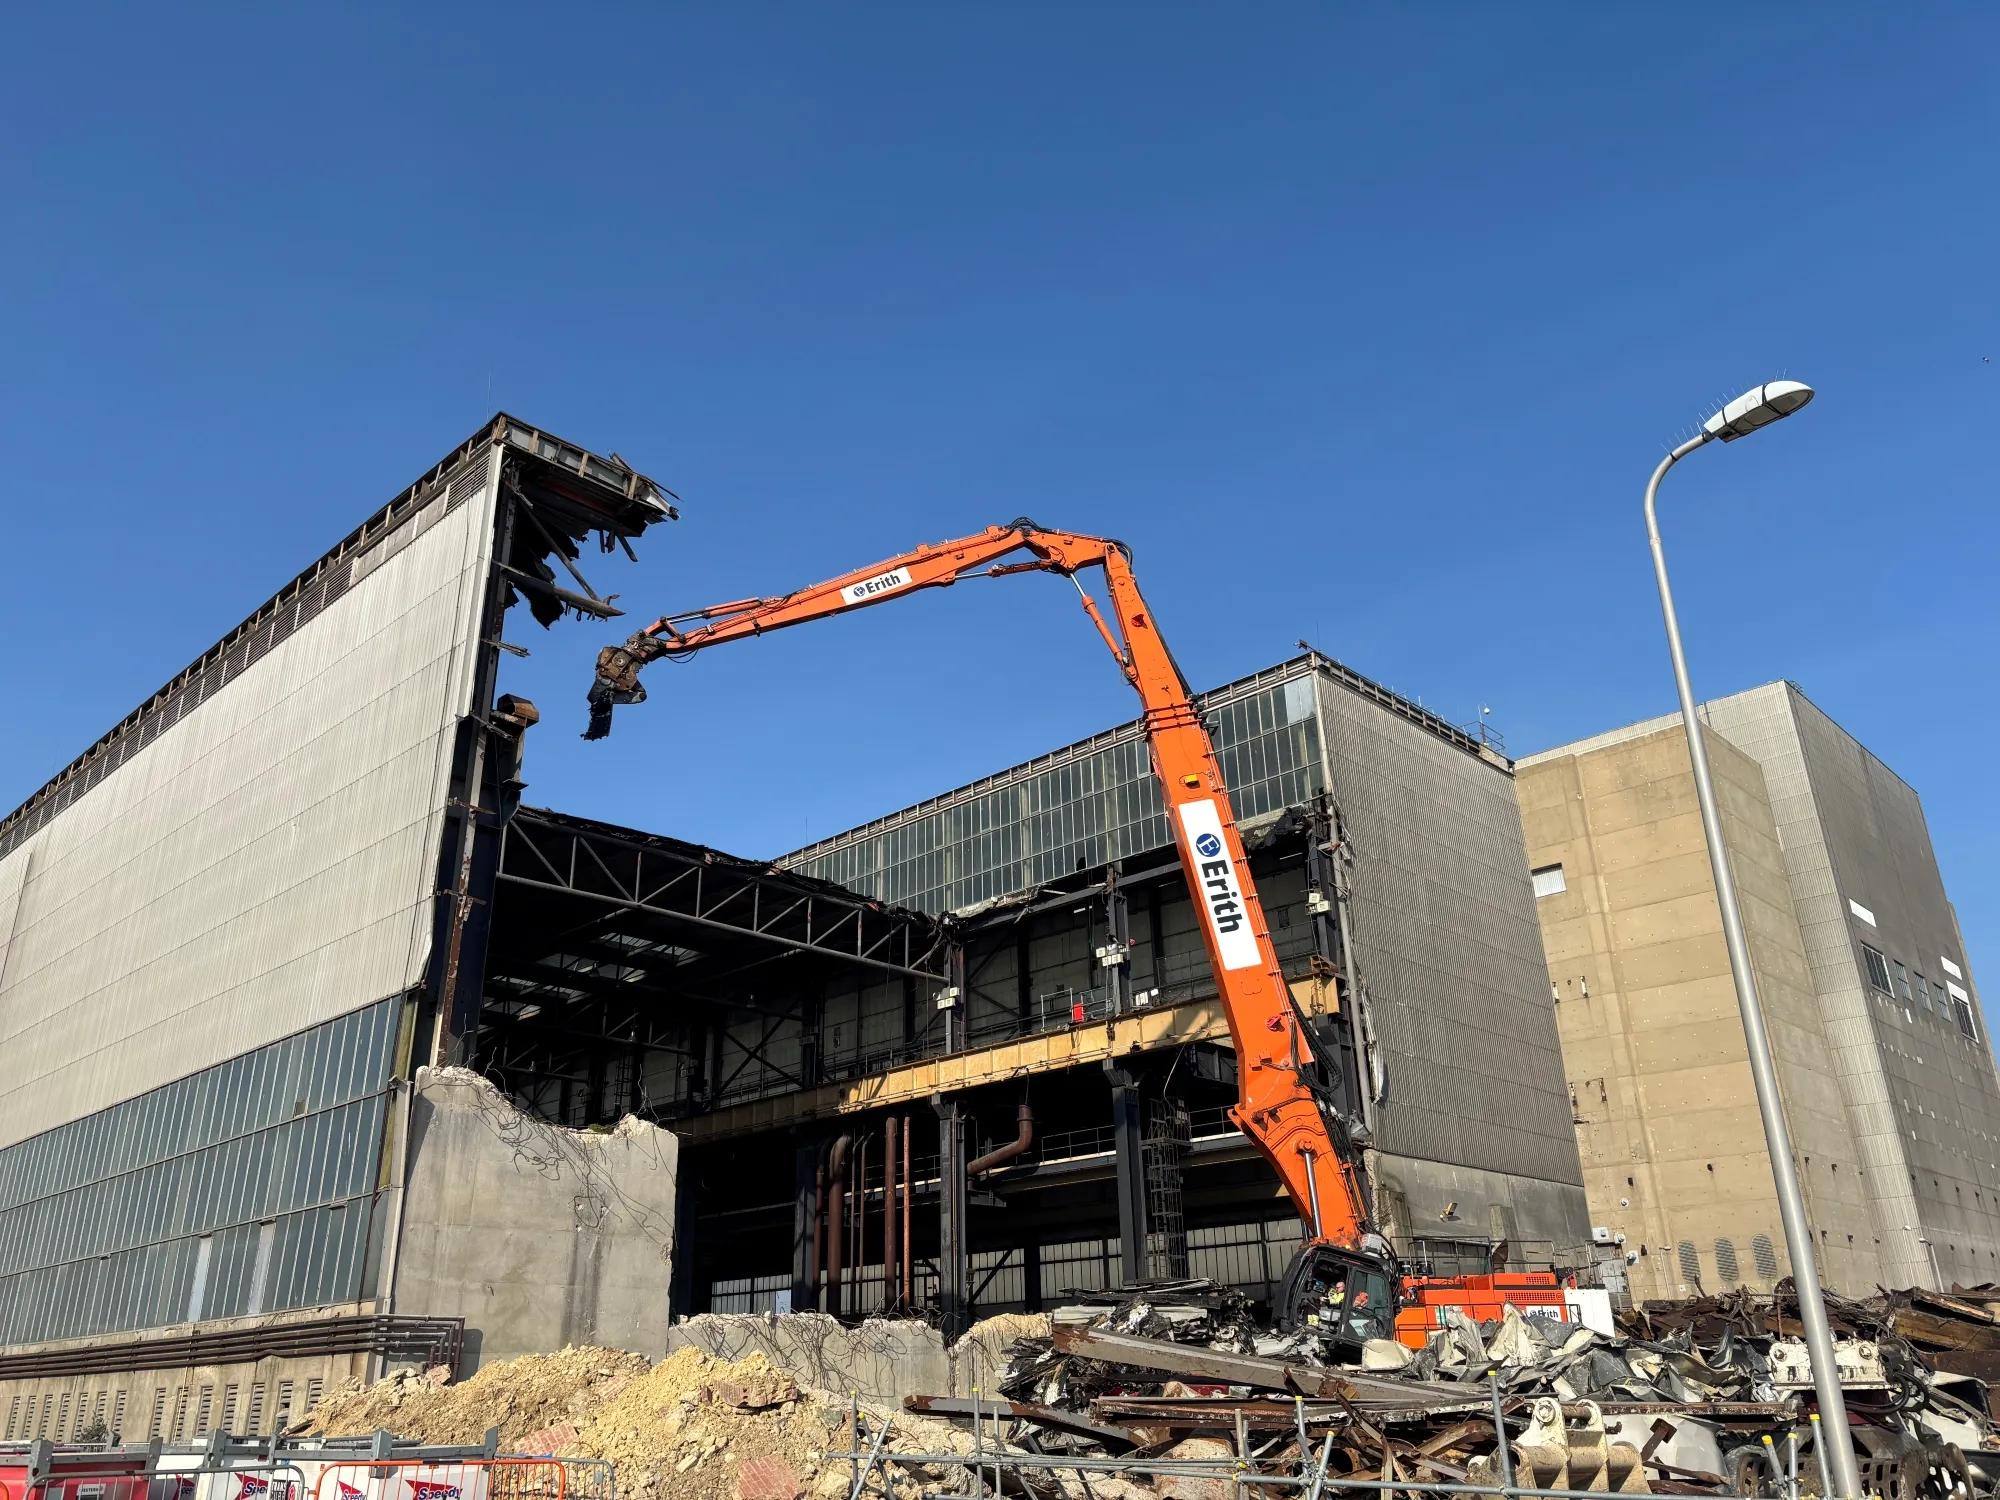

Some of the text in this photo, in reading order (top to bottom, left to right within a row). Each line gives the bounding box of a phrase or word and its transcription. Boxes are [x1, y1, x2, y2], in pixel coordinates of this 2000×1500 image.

[865, 574, 901, 594] Erith
[1201, 859, 1243, 934] Erith
[418, 1486, 463, 1500] Speedy
